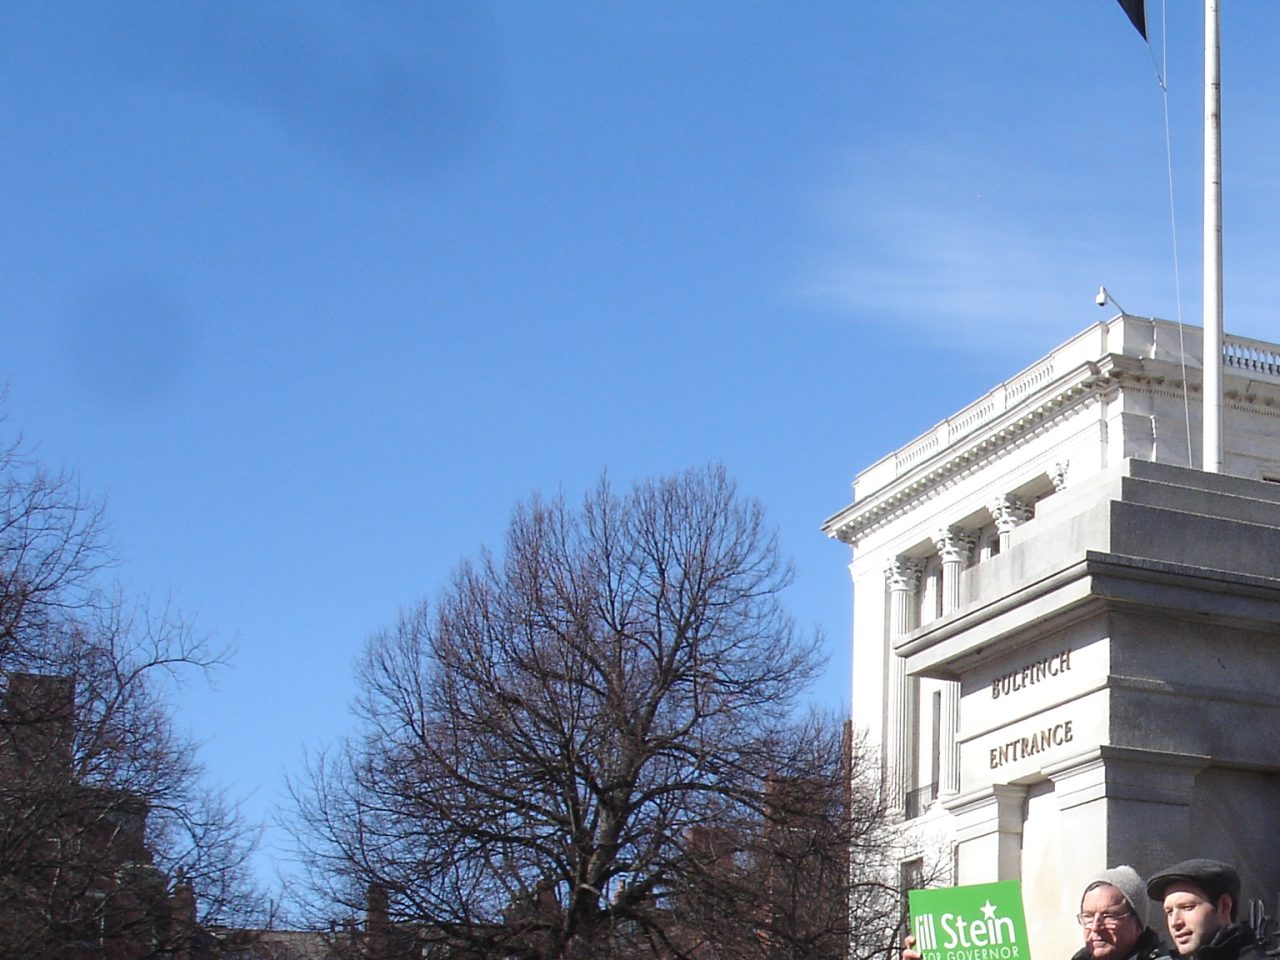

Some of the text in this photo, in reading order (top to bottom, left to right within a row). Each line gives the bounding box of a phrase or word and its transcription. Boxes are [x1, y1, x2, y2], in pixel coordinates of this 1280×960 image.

[991, 650, 1072, 700] BULFINCH
[989, 720, 1073, 770] ENTRANCE
[915, 900, 1016, 955] Jill Stein
